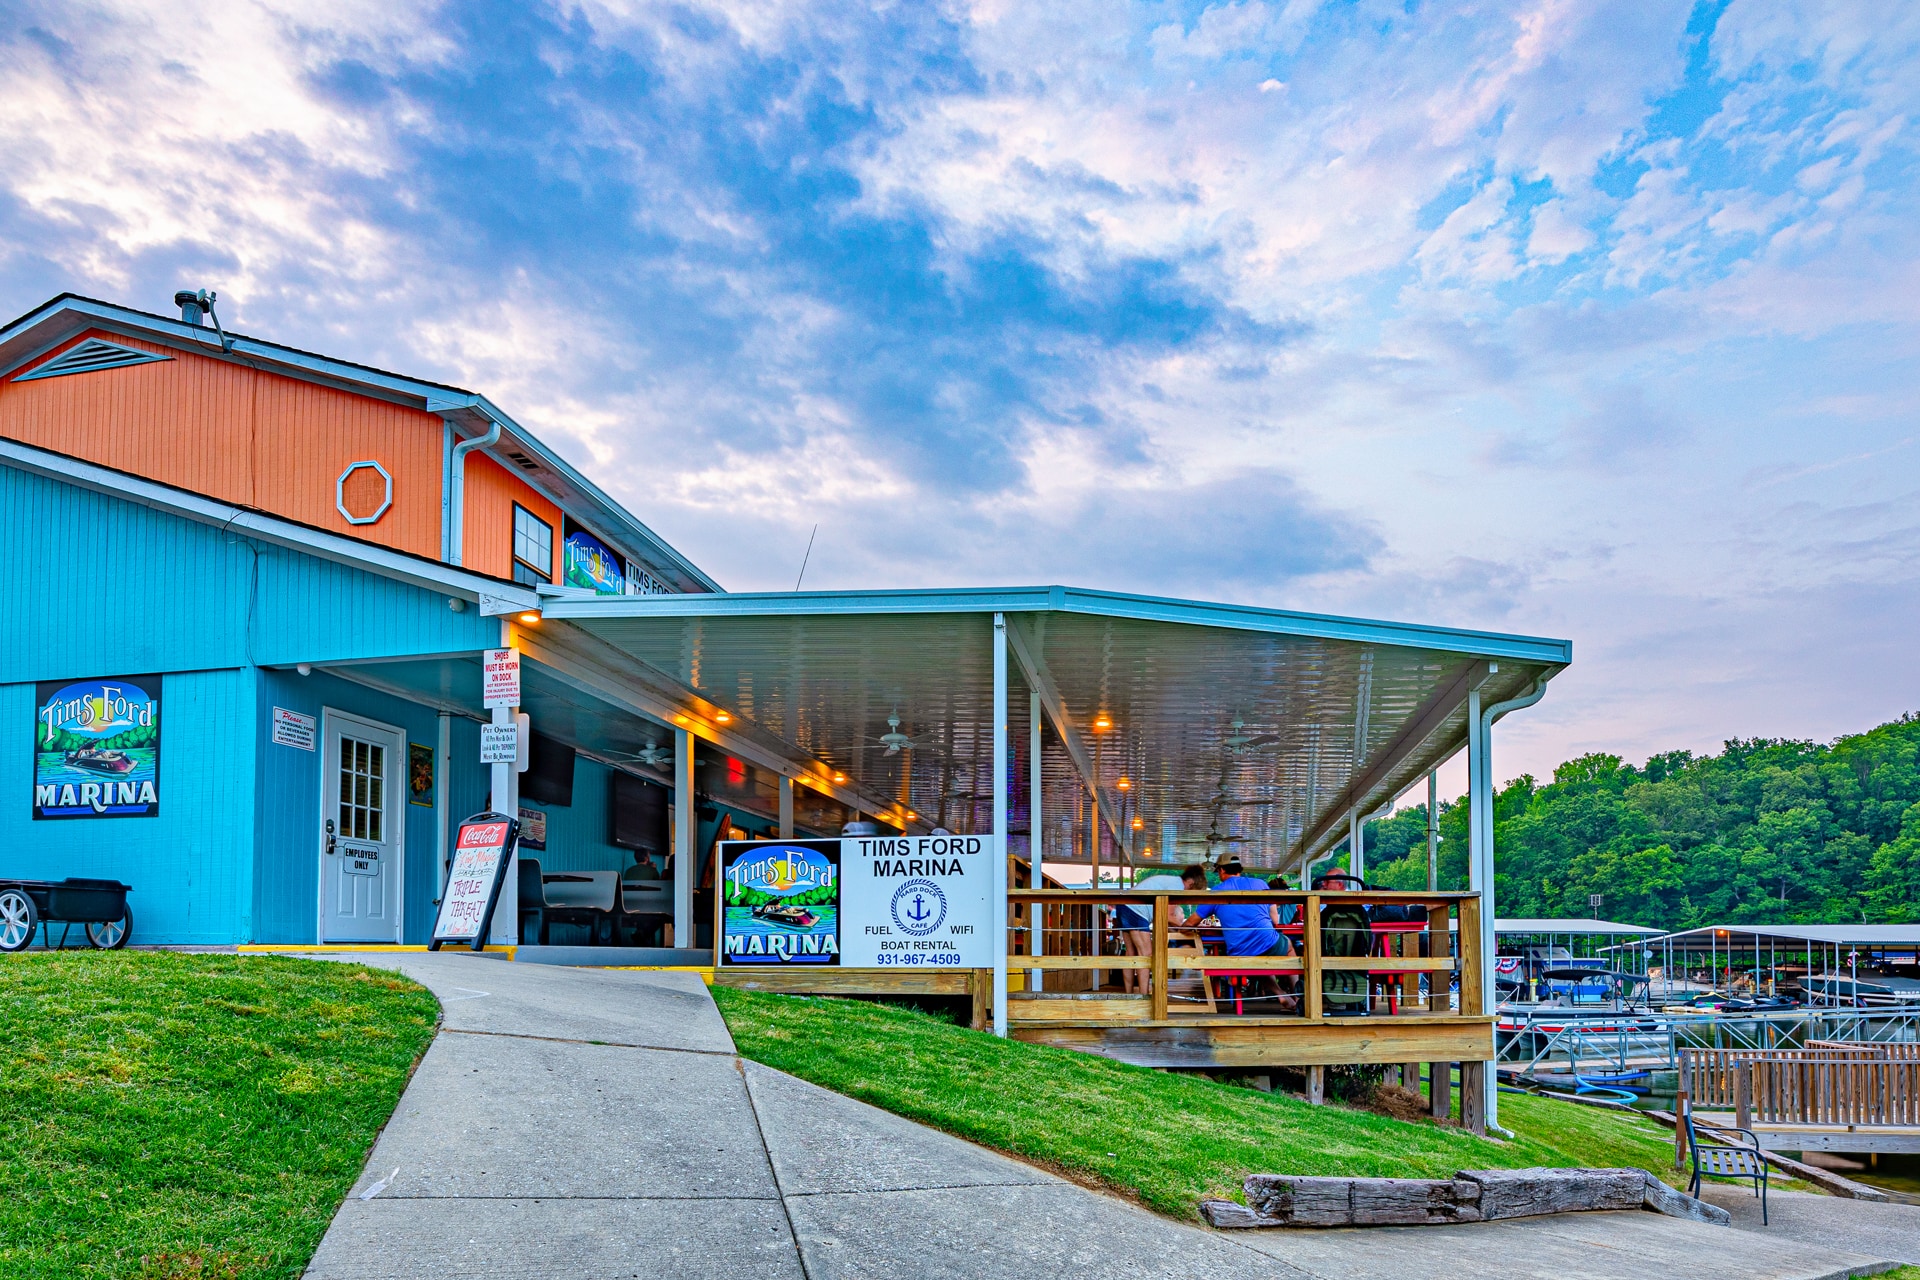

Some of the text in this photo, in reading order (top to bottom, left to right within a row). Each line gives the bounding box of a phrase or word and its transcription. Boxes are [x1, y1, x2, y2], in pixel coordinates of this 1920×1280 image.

[568, 538, 623, 595] Tims Ford
[627, 561, 650, 590] TIMS
[494, 651, 509, 660] SHOES
[485, 661, 519, 672] MUST BE WORN
[492, 672, 512, 682] ON DOCK
[41, 685, 154, 743] Tims Ford
[281, 720, 303, 730] PERSONAL
[277, 730, 312, 743] ALLOWED DURING
[286, 727, 310, 737] BEVERAGES
[278, 735, 311, 747] ENTERTAINMENT
[36, 781, 158, 813] MARINA
[859, 838, 981, 857] TIMS FORD
[345, 848, 378, 860] EMPLOYEES
[354, 860, 369, 870] ONLY
[873, 859, 964, 877] MARINA
[728, 850, 832, 899] Tims Ford
[454, 880, 483, 898] TRIPLE
[900, 887, 938, 899] HARD DOCK
[451, 900, 486, 923] THREAT
[865, 925, 974, 935] FUEL WIFI
[724, 934, 839, 961] MARINA
[881, 941, 957, 950] BOAT RENTAL
[877, 953, 961, 965] 931-967-4509
